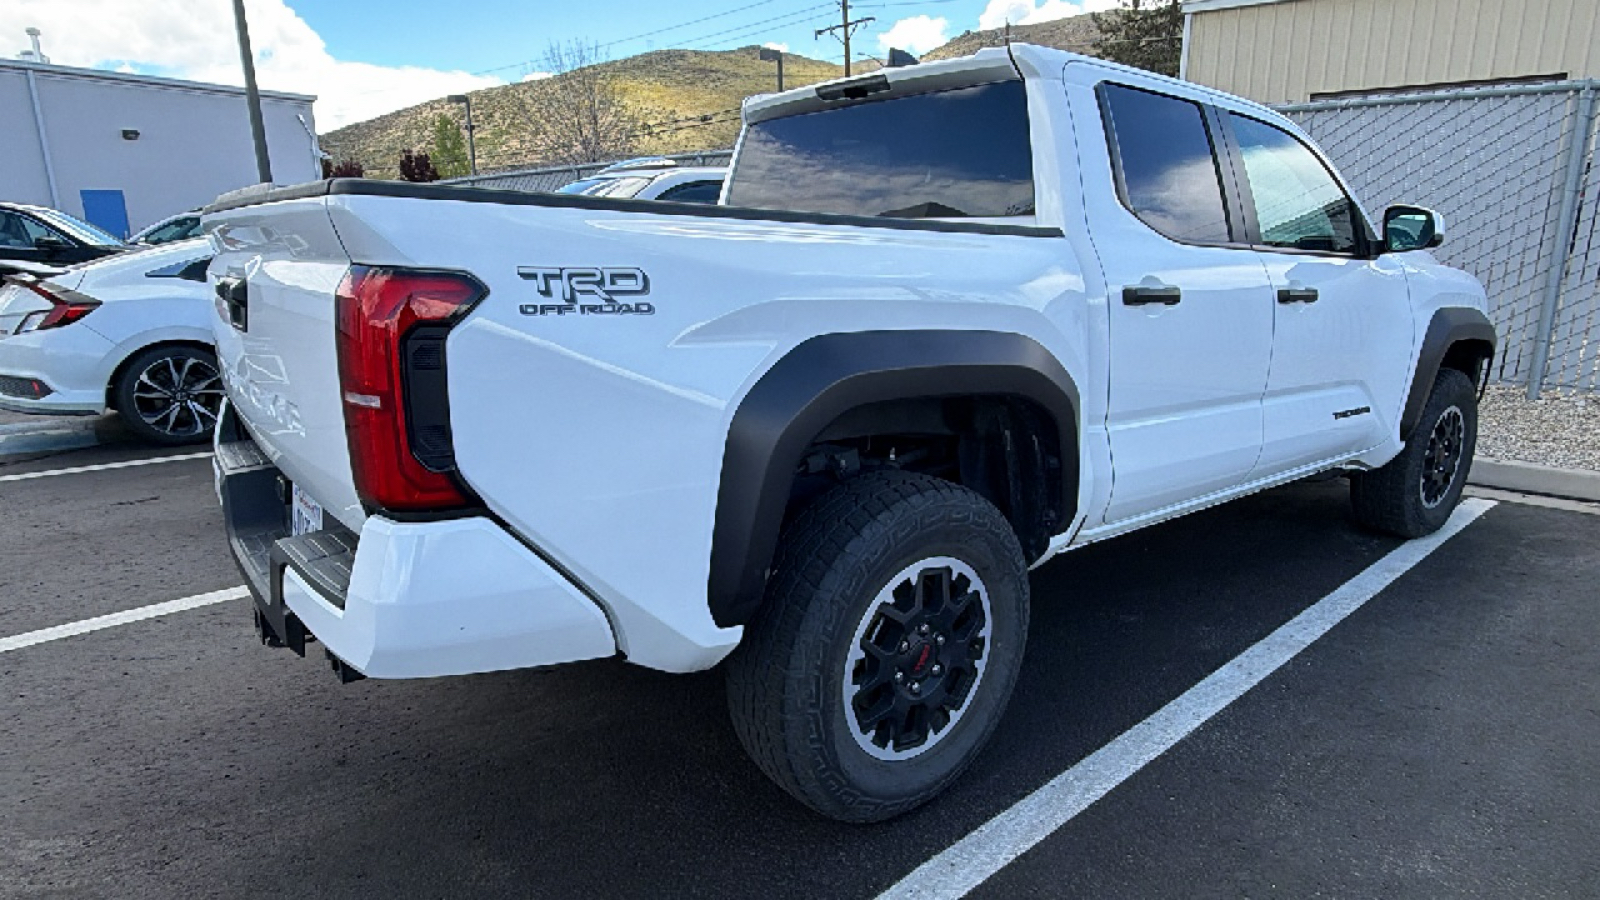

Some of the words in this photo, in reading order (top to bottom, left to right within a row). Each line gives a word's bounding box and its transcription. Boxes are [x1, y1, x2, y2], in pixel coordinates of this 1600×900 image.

[517, 266, 650, 304] TRD
[519, 304, 576, 316] OFF
[580, 302, 656, 316] ROAD
